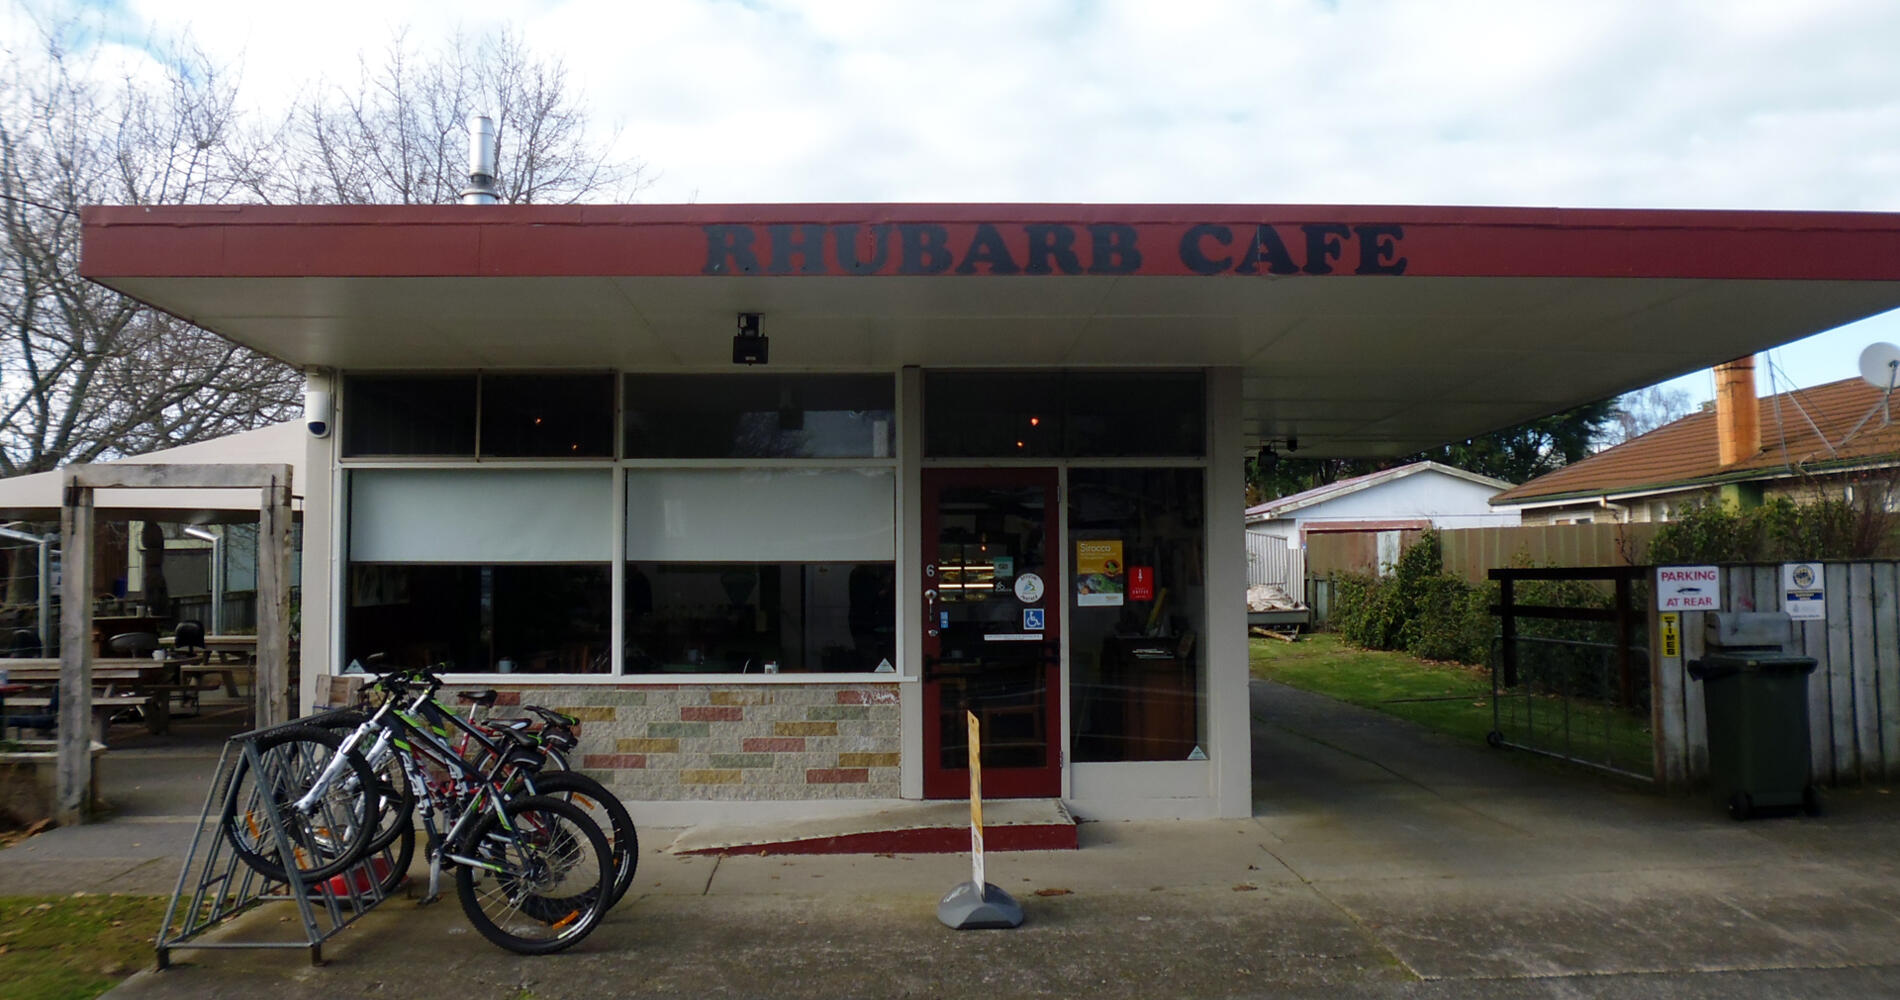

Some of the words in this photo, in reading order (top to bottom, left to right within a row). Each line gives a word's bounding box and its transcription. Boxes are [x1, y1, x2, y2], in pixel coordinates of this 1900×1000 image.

[702, 223, 1142, 275] RHUBARB
[1179, 223, 1407, 275] CAFE
[926, 564, 935, 577] 6
[1661, 570, 1716, 582] PARKING
[1667, 597, 1680, 607] AT
[1684, 597, 1713, 607] REAR
